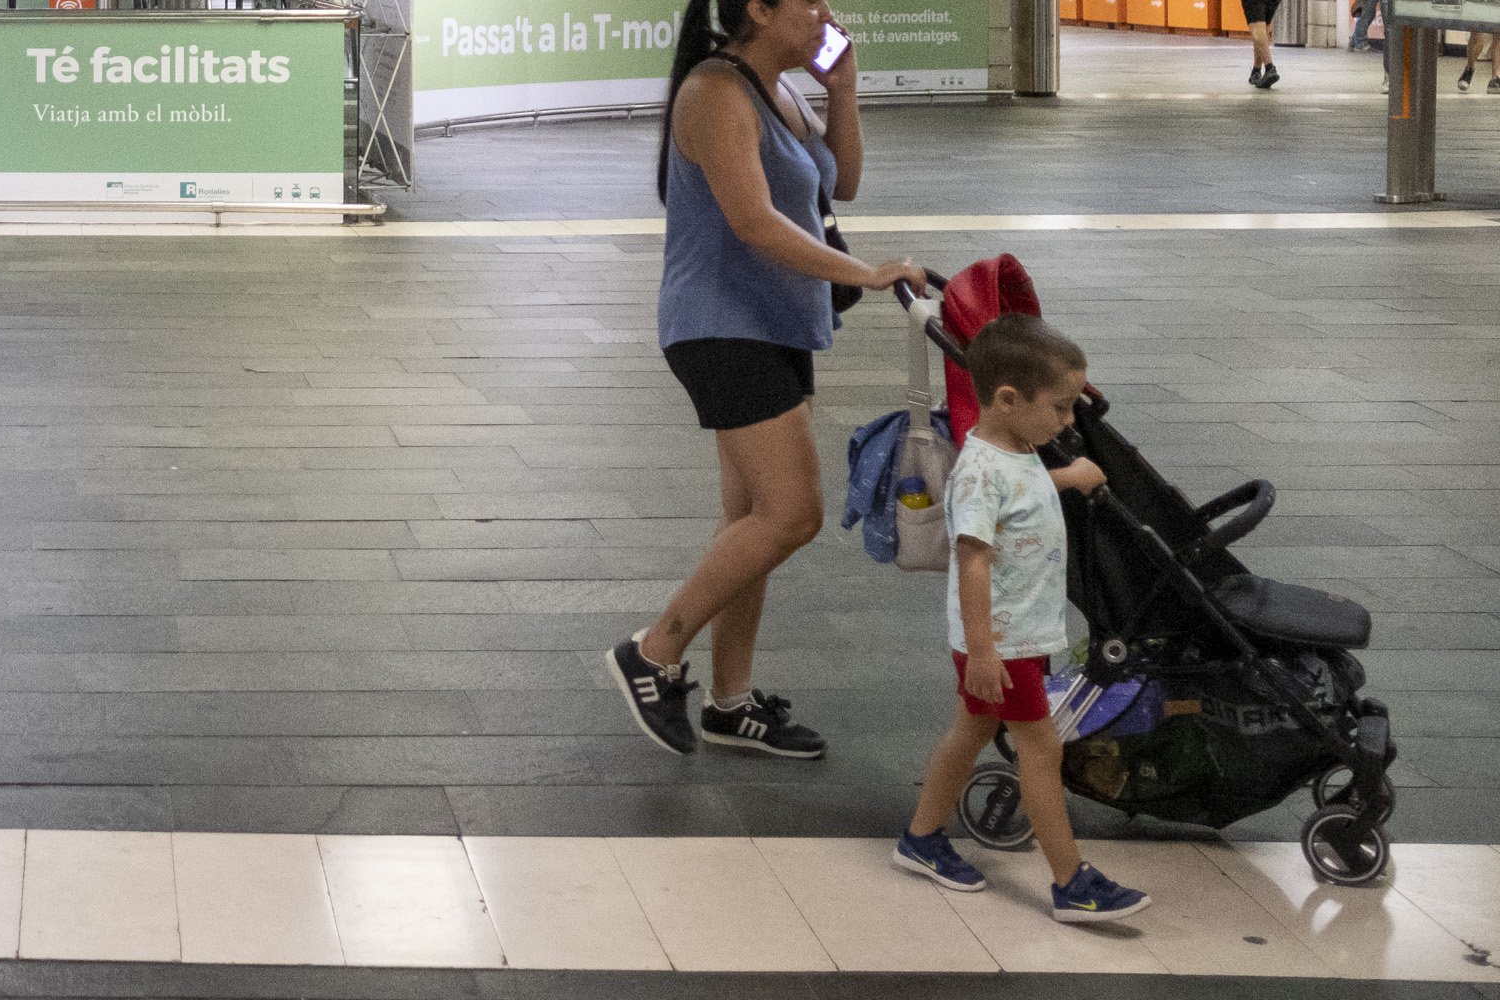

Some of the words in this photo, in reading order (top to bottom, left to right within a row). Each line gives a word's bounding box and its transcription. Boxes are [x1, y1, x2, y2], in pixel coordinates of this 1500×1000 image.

[868, 10, 881, 24] té
[882, 9, 952, 25] comoditat,
[442, 14, 533, 58] Passa't
[539, 22, 556, 52] a
[564, 12, 588, 51] la
[873, 30, 886, 43] té
[888, 29, 961, 45] avantatges.
[26, 44, 80, 84] Té
[91, 43, 291, 85] facilitats
[32, 103, 91, 129] Viatja
[97, 104, 140, 123] amb
[146, 103, 162, 123] el
[169, 103, 232, 123] mòbil.
[198, 187, 230, 196] Rodalies
[633, 676, 661, 703] m
[738, 716, 768, 739] m
